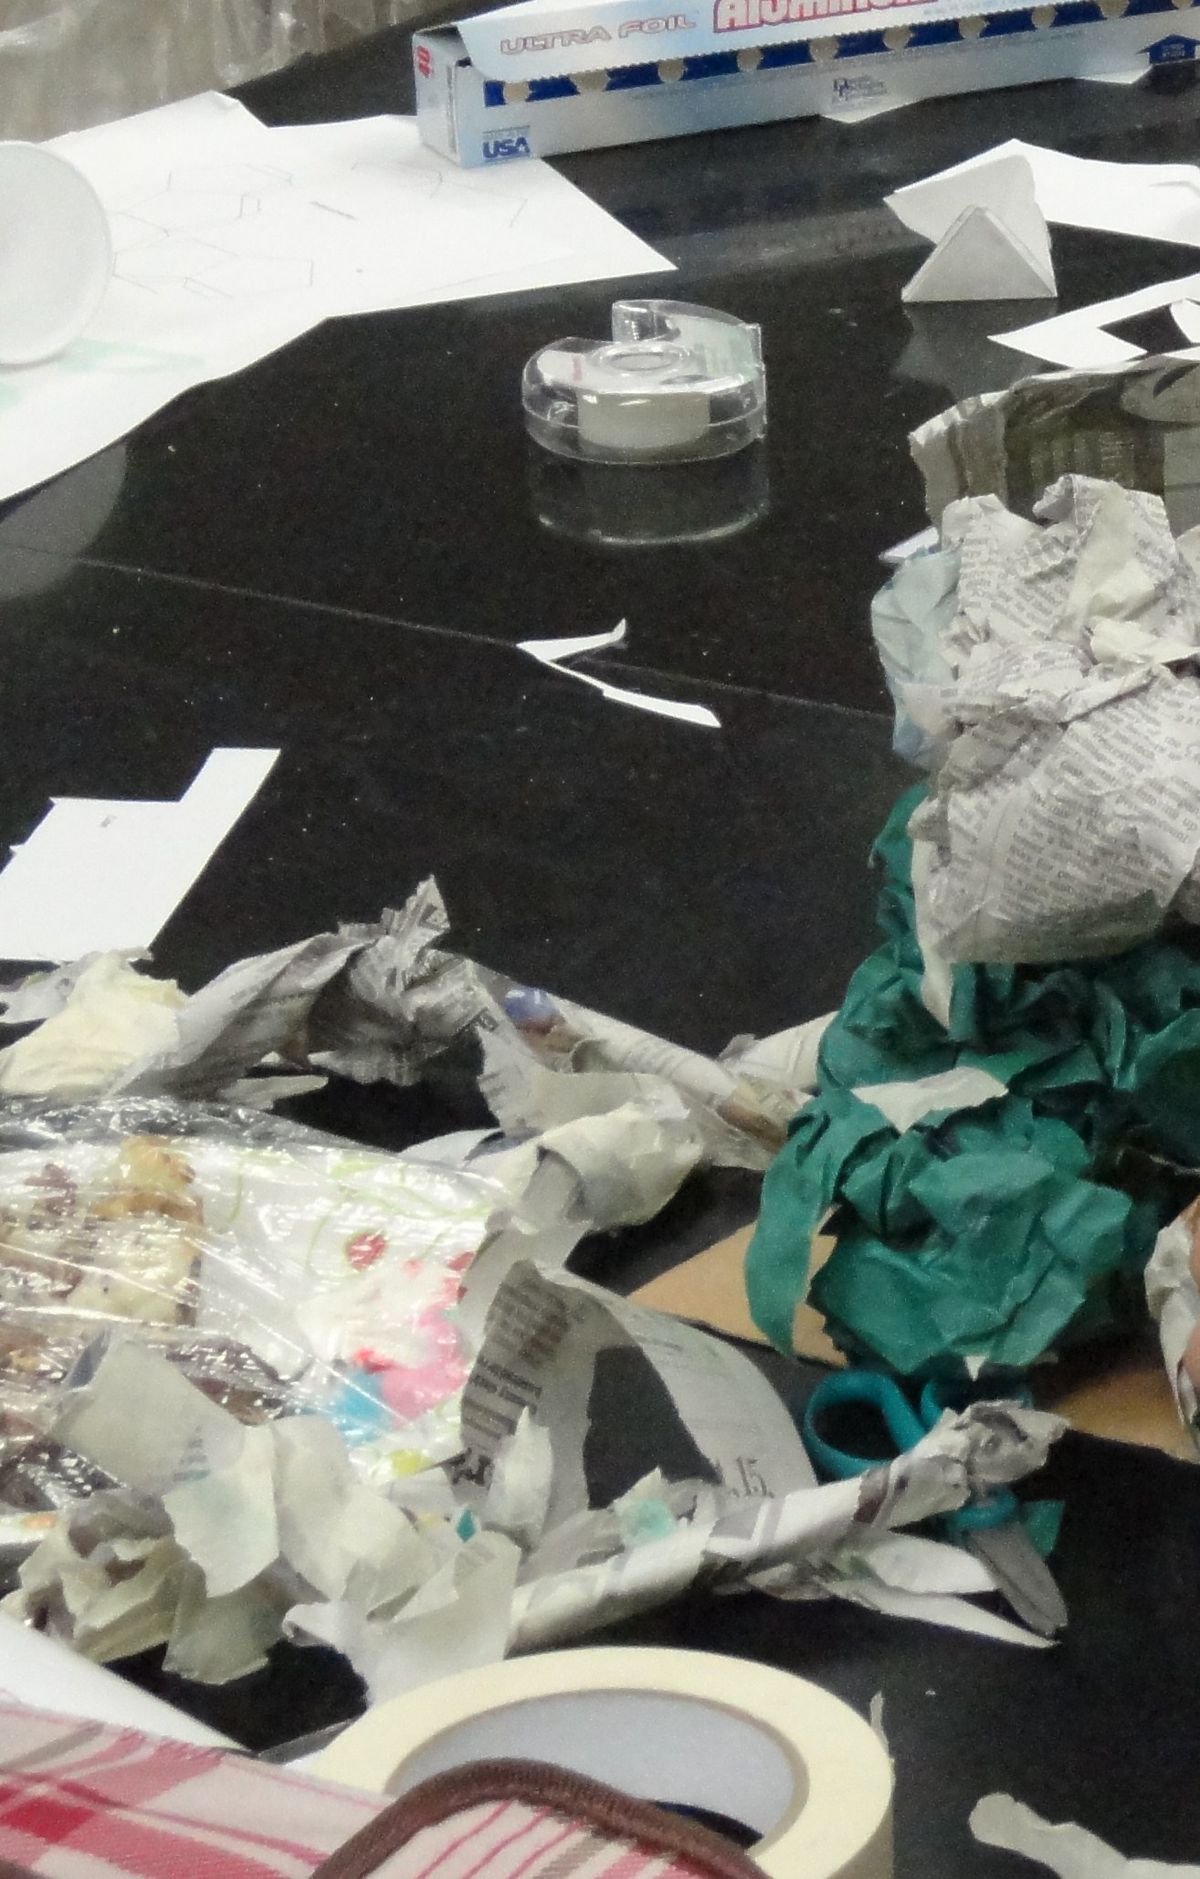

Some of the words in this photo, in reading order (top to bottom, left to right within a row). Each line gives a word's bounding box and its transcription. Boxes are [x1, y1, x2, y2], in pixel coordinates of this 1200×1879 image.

[501, 26, 612, 55] ULTRA
[619, 15, 696, 39] FOIL
[482, 137, 530, 159] USA
